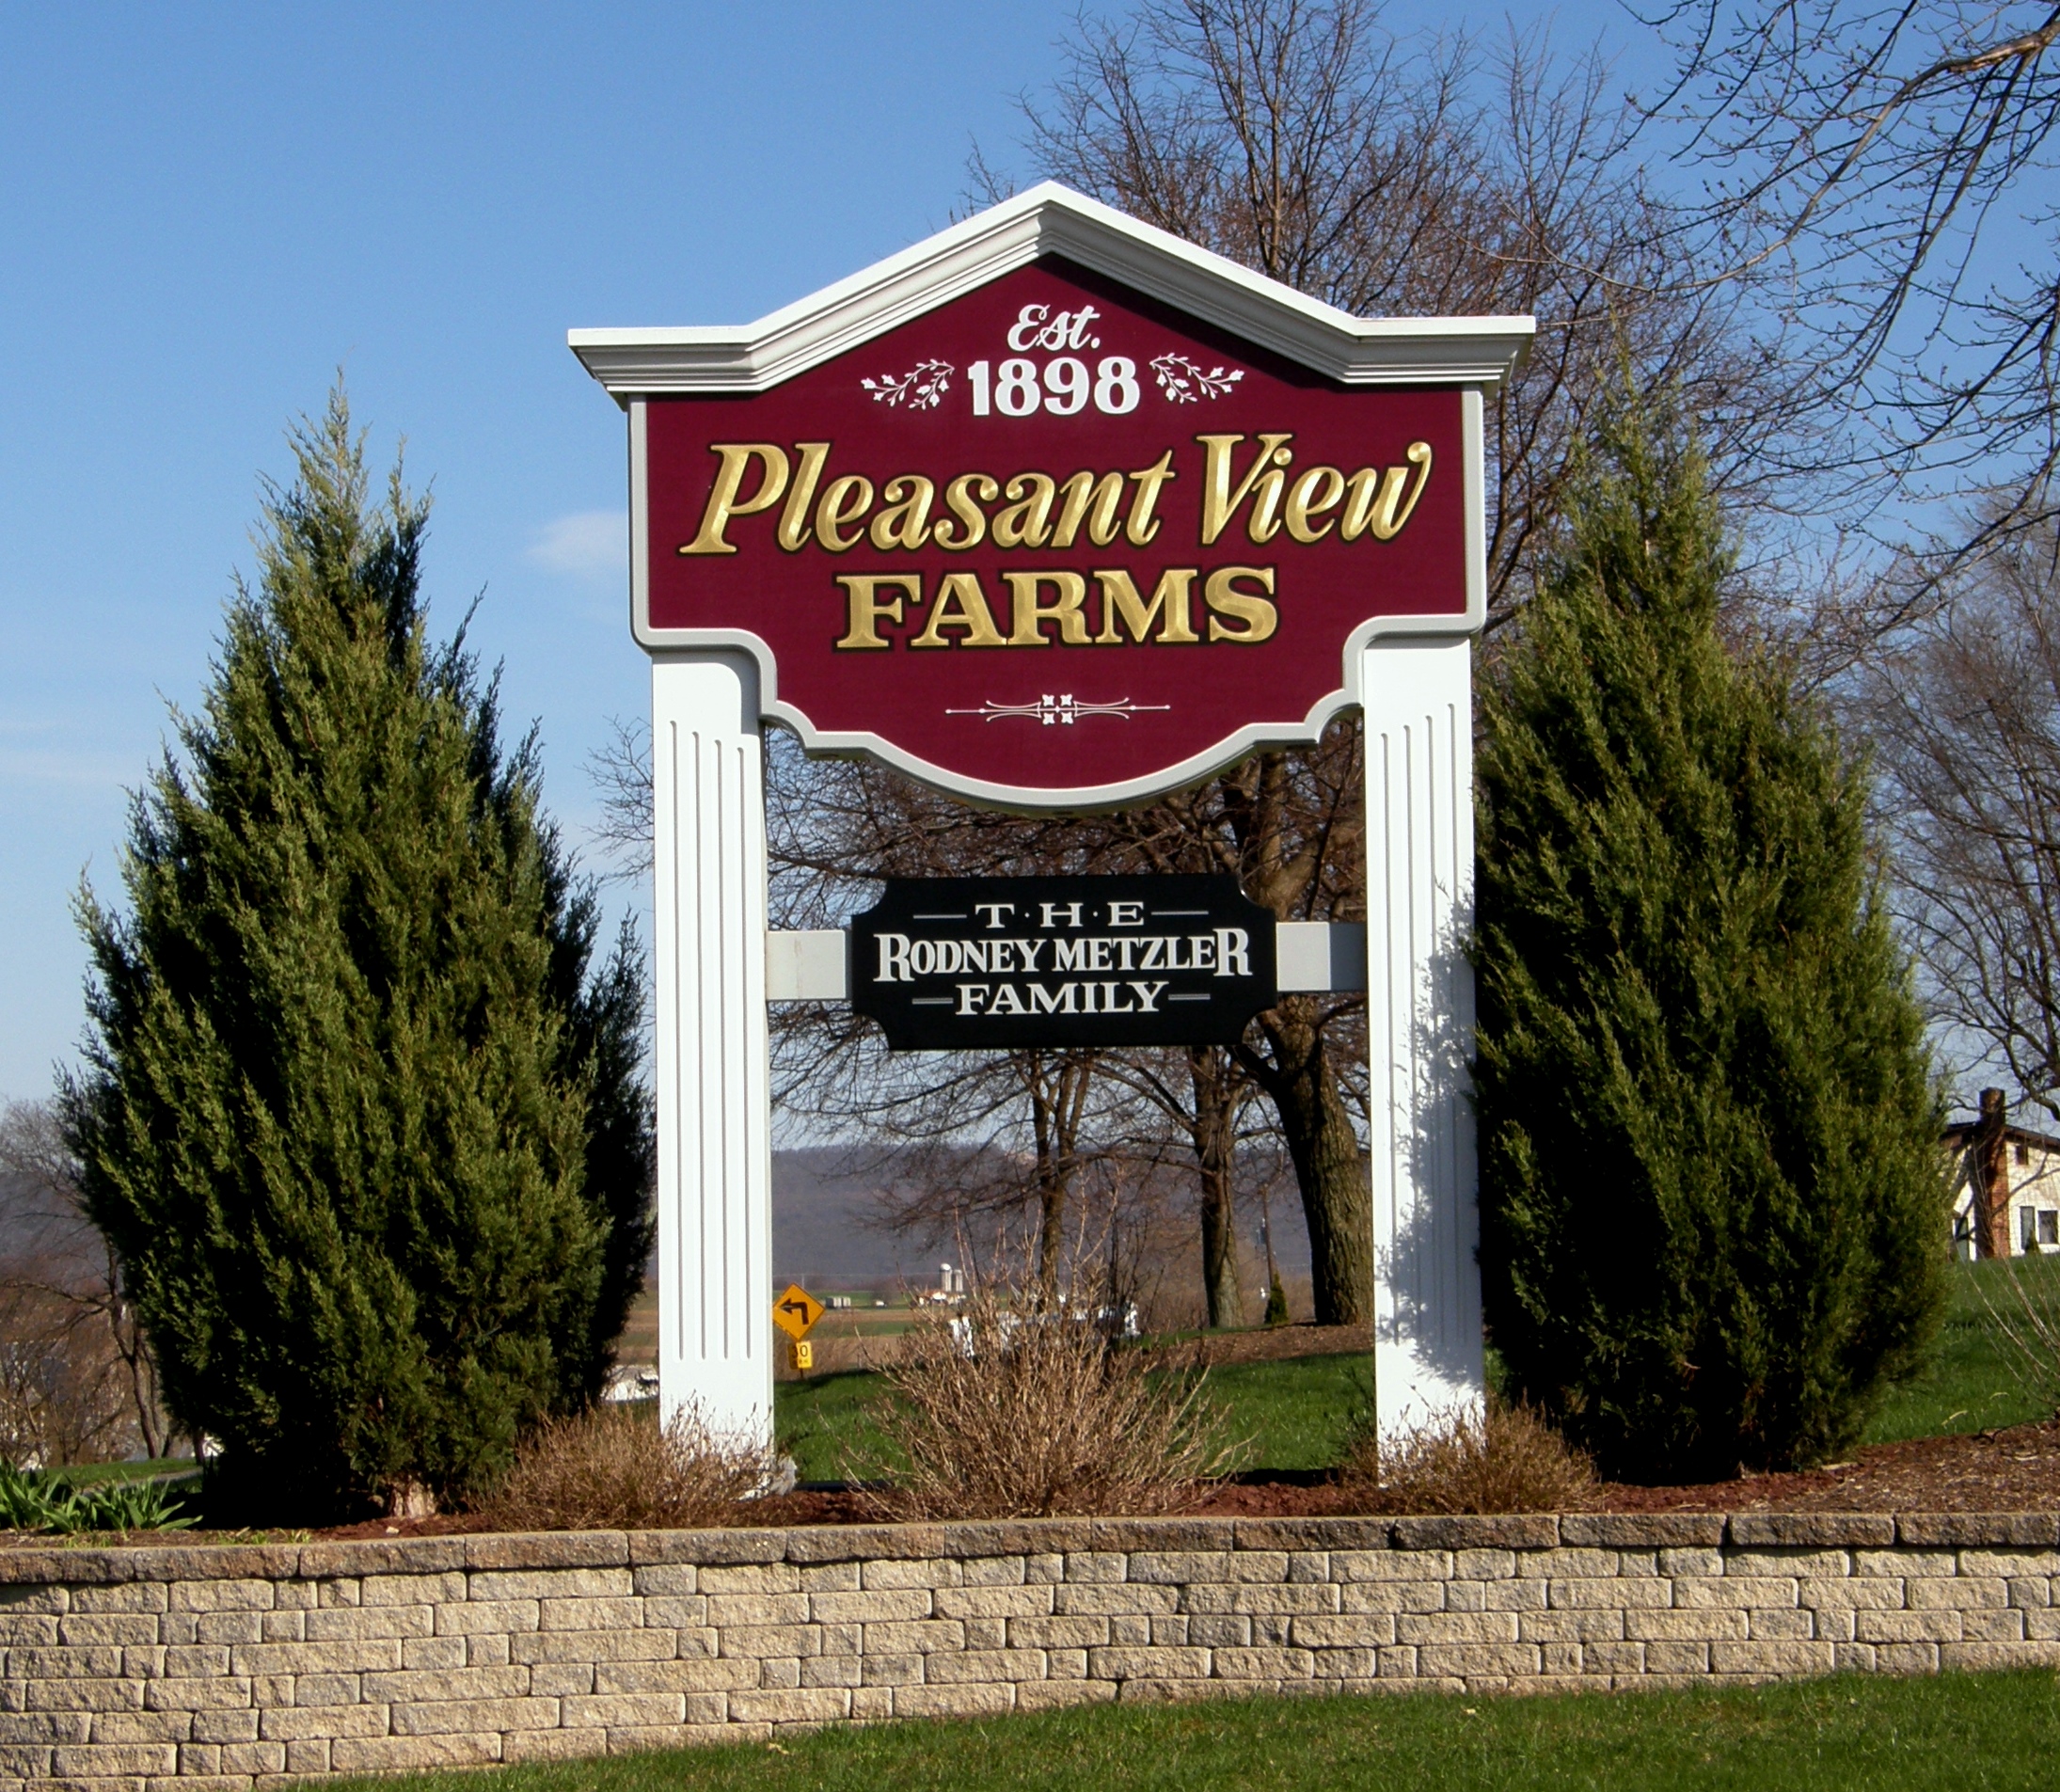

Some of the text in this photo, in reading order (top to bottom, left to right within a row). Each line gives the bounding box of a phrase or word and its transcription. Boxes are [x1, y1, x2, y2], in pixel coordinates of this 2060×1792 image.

[1006, 304, 1101, 352] Est.
[968, 357, 1140, 416] 1898
[677, 433, 1432, 555] Pleasant View
[834, 565, 1280, 649] FARMS
[873, 928, 1253, 982] RODNEY METZLER
[955, 981, 1169, 1015] FAMILY
